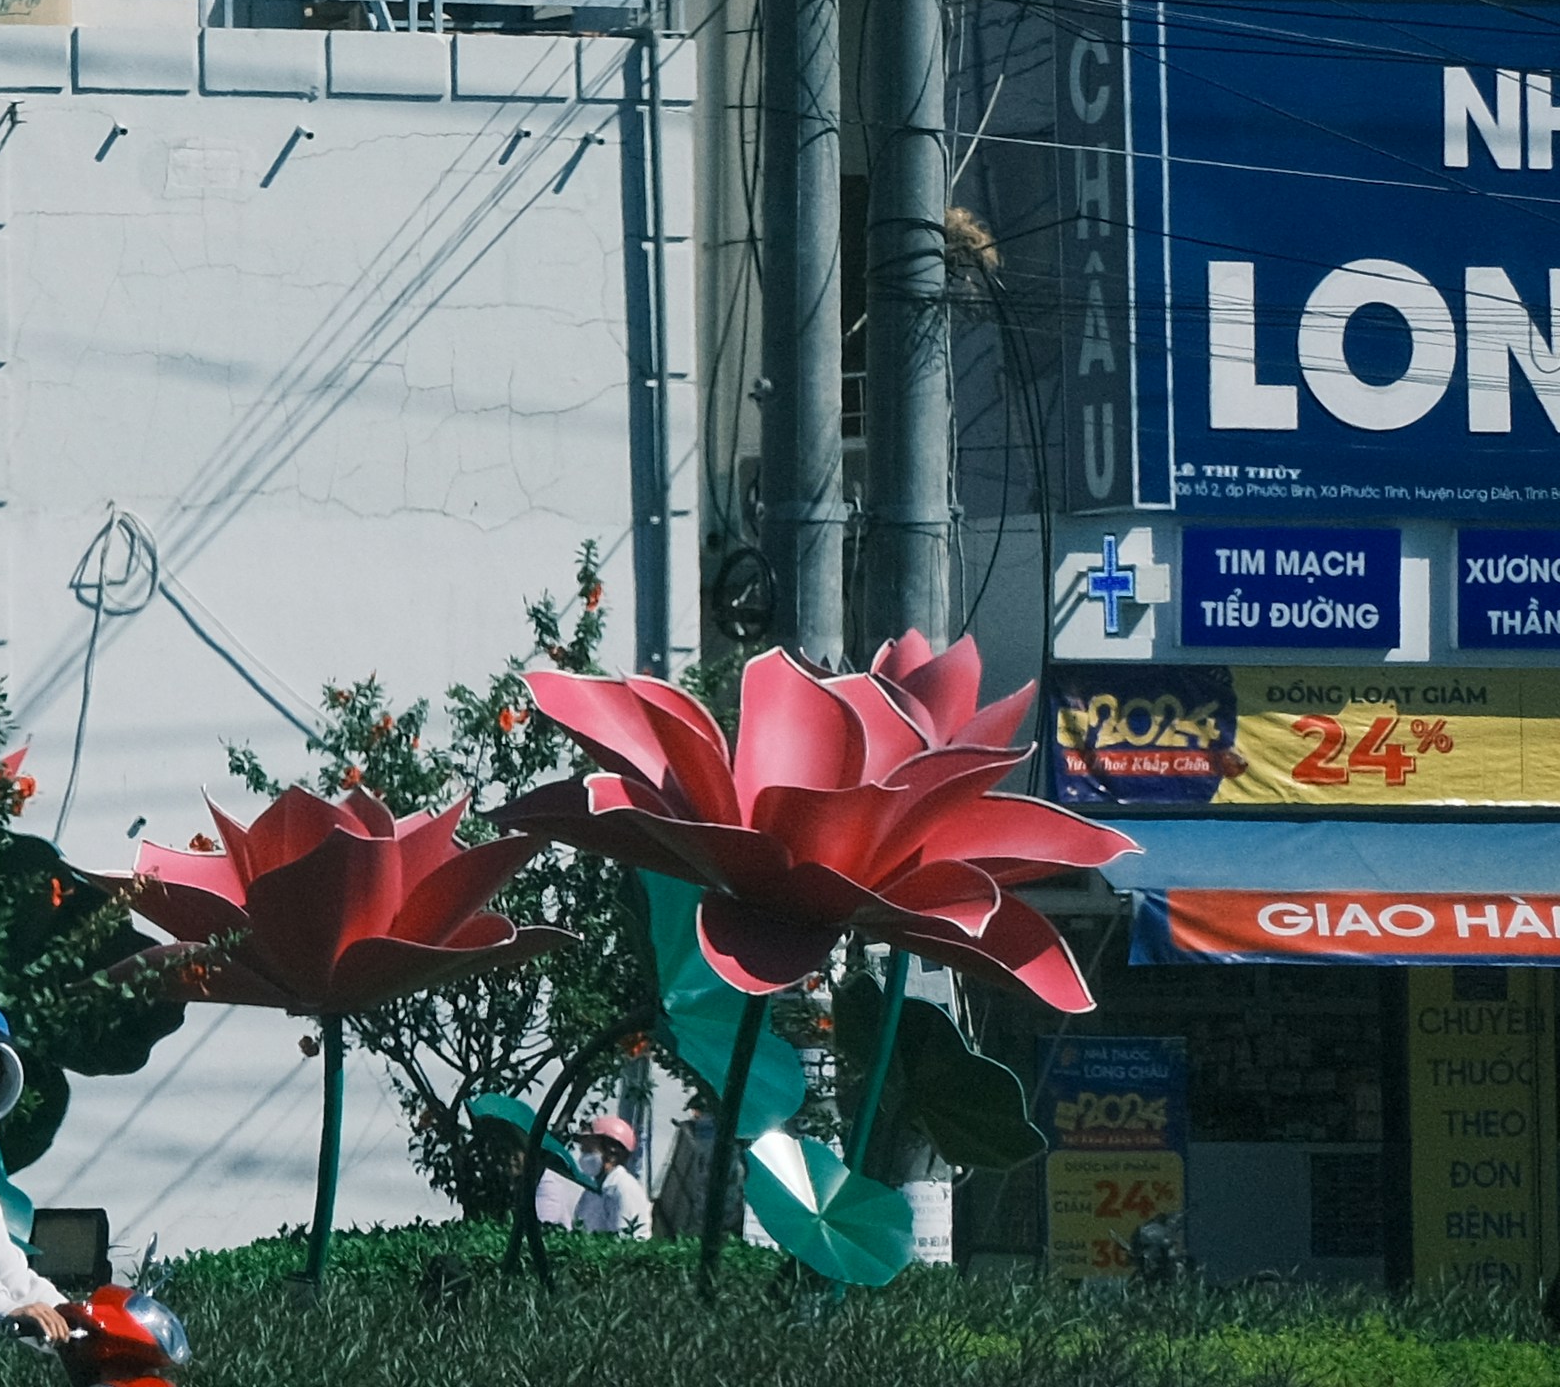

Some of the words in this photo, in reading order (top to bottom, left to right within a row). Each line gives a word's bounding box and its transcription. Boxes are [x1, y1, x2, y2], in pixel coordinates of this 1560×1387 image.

[1068, 35, 1116, 499] CHÂU
[1215, 548, 1266, 576] TIM
[1275, 549, 1366, 584] MẠCH
[1200, 588, 1261, 627] TIỂU
[1269, 596, 1380, 629] ĐƯỜNG
[1266, 679, 1344, 704] ĐỒNG
[1089, 693, 1221, 749] 2024
[1291, 714, 1454, 787] 24%
[1257, 902, 1436, 937] GIAO
[1453, 895, 1560, 938] HÀ
[1418, 1001, 1546, 1035] CHUYÊN
[1441, 1109, 1527, 1137] THEO
[1094, 1179, 1175, 1220] 24%
[1446, 1204, 1528, 1247] BỆNH
